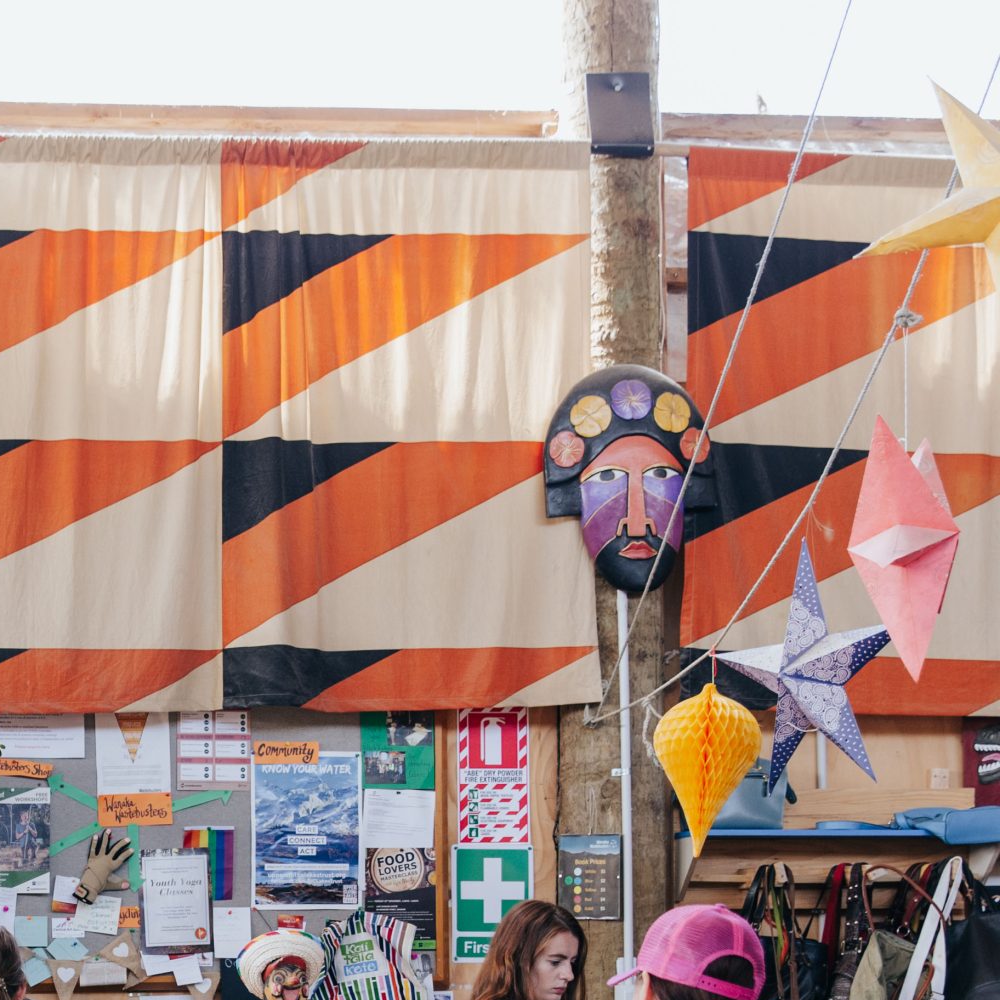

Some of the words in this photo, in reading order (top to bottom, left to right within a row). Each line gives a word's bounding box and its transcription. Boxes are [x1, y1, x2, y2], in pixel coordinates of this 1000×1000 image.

[257, 743, 314, 763] Community
[262, 765, 289, 774] KNOW
[293, 764, 318, 774] YOUR
[319, 764, 352, 775] WATER
[104, 795, 136, 812] Wanaka
[115, 803, 168, 822] Wastebusters
[377, 852, 415, 867] FOOD
[378, 862, 417, 875] LOVERS
[150, 879, 176, 887] Youth
[464, 941, 491, 953] Firs
